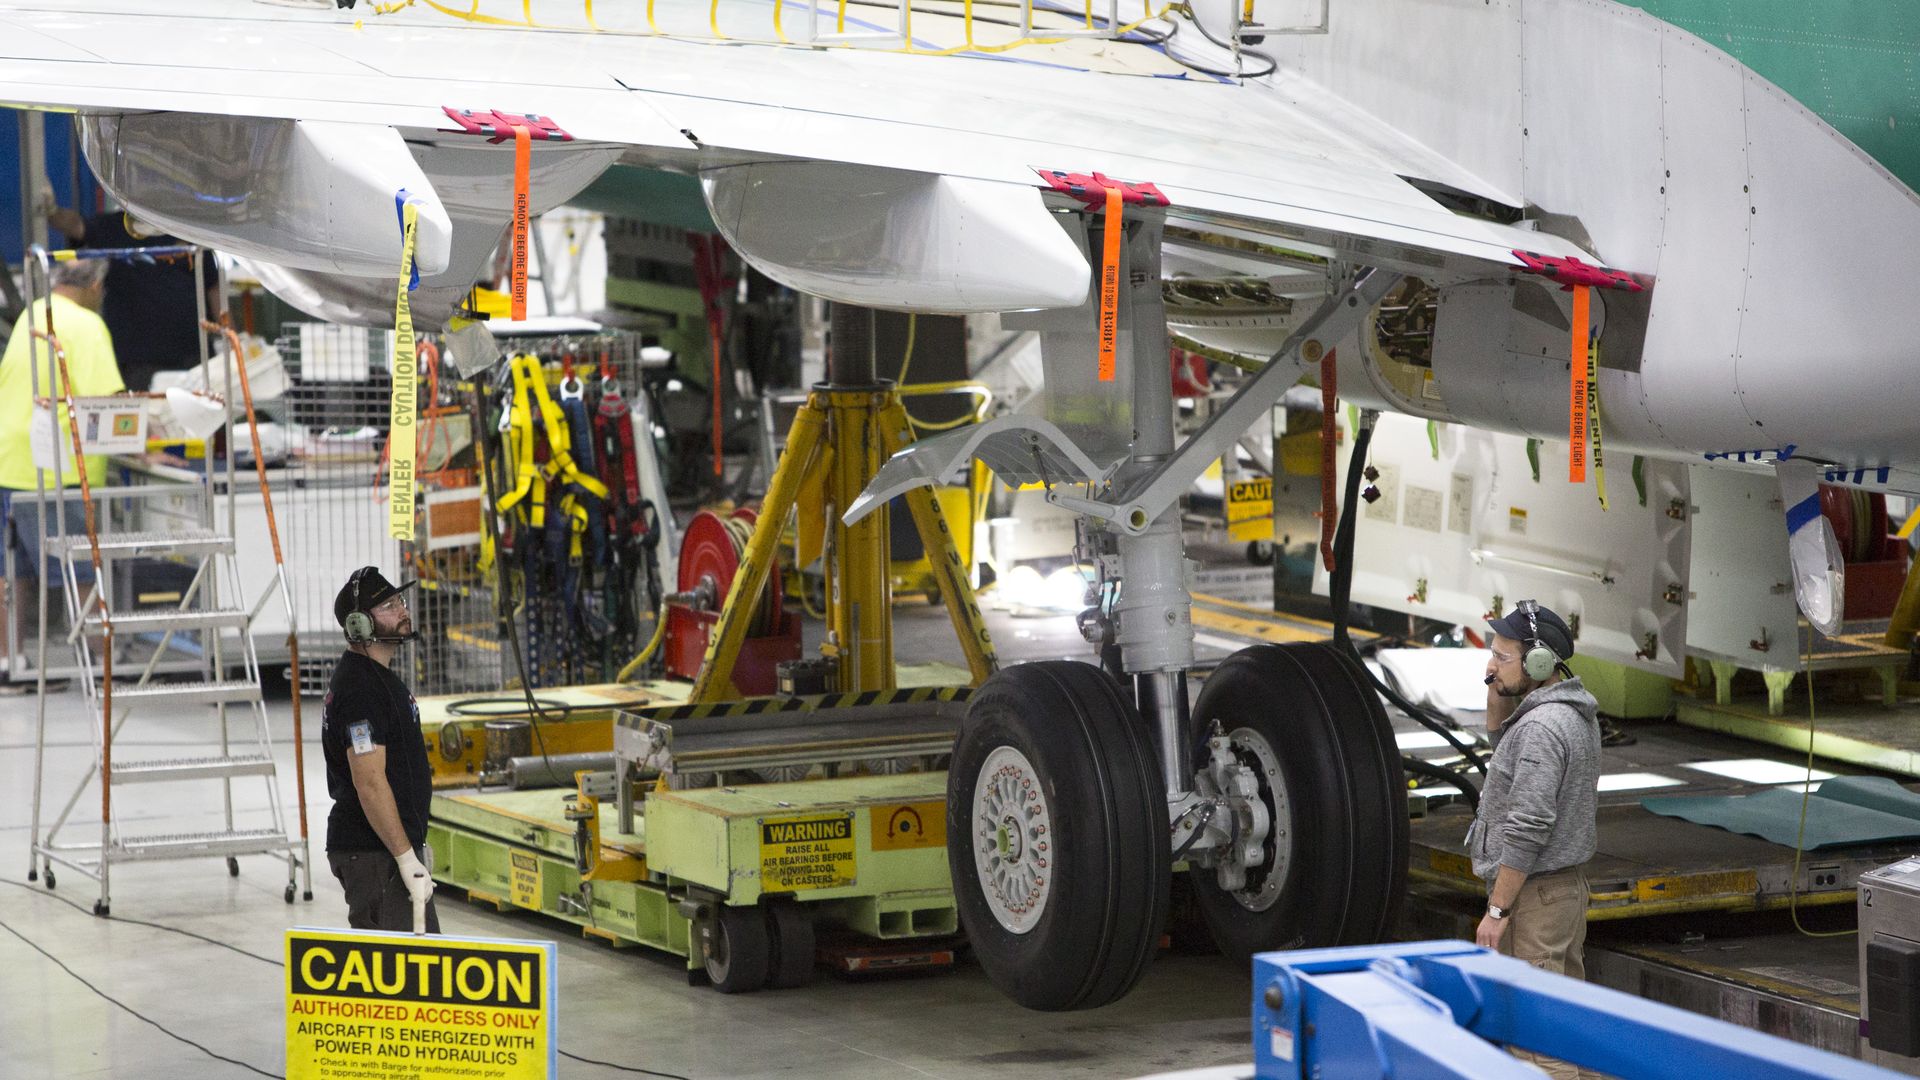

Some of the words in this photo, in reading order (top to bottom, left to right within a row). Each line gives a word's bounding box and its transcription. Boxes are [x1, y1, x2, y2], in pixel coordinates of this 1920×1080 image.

[516, 193, 526, 231] REMOVE
[515, 271, 525, 304] FLIGHT
[1104, 294, 1114, 309] SHOP
[1574, 380, 1584, 410] REMOVE
[1587, 381, 1597, 413] NOT
[1574, 412, 1583, 440] BEFORE
[1573, 441, 1583, 467] FLIGHT
[1590, 417, 1603, 469] ENTER
[769, 821, 846, 842] WARNING
[763, 857, 777, 867] AIR
[779, 854, 820, 866] BEARINGS
[822, 851, 853, 862] BEFORE
[786, 845, 812, 855] RAISE
[814, 843, 830, 852] ALL
[795, 875, 833, 885] CASTERS
[1863, 888, 1873, 908] 12
[301, 946, 531, 1003] CAUTION
[292, 999, 409, 1021] AUTHORIZED
[414, 1006, 487, 1026] ACCESS
[492, 1013, 540, 1030] ONLY
[297, 1021, 375, 1039] AIRCRAFT
[380, 1026, 395, 1040] IS
[400, 1028, 491, 1046] ENERGIZED
[495, 1034, 535, 1049] WITH
[315, 1039, 372, 1055] POWER
[377, 1043, 410, 1058] AND
[416, 1046, 518, 1065] HYDRAULICS
[320, 1057, 347, 1066] Check
[361, 1061, 379, 1069] with
[381, 1062, 408, 1072] Barge
[409, 1064, 422, 1072] for
[424, 1065, 482, 1076] authorization
[484, 1070, 506, 1078] prior
[320, 1068, 330, 1076] to
[331, 1069, 386, 1080] approaching
